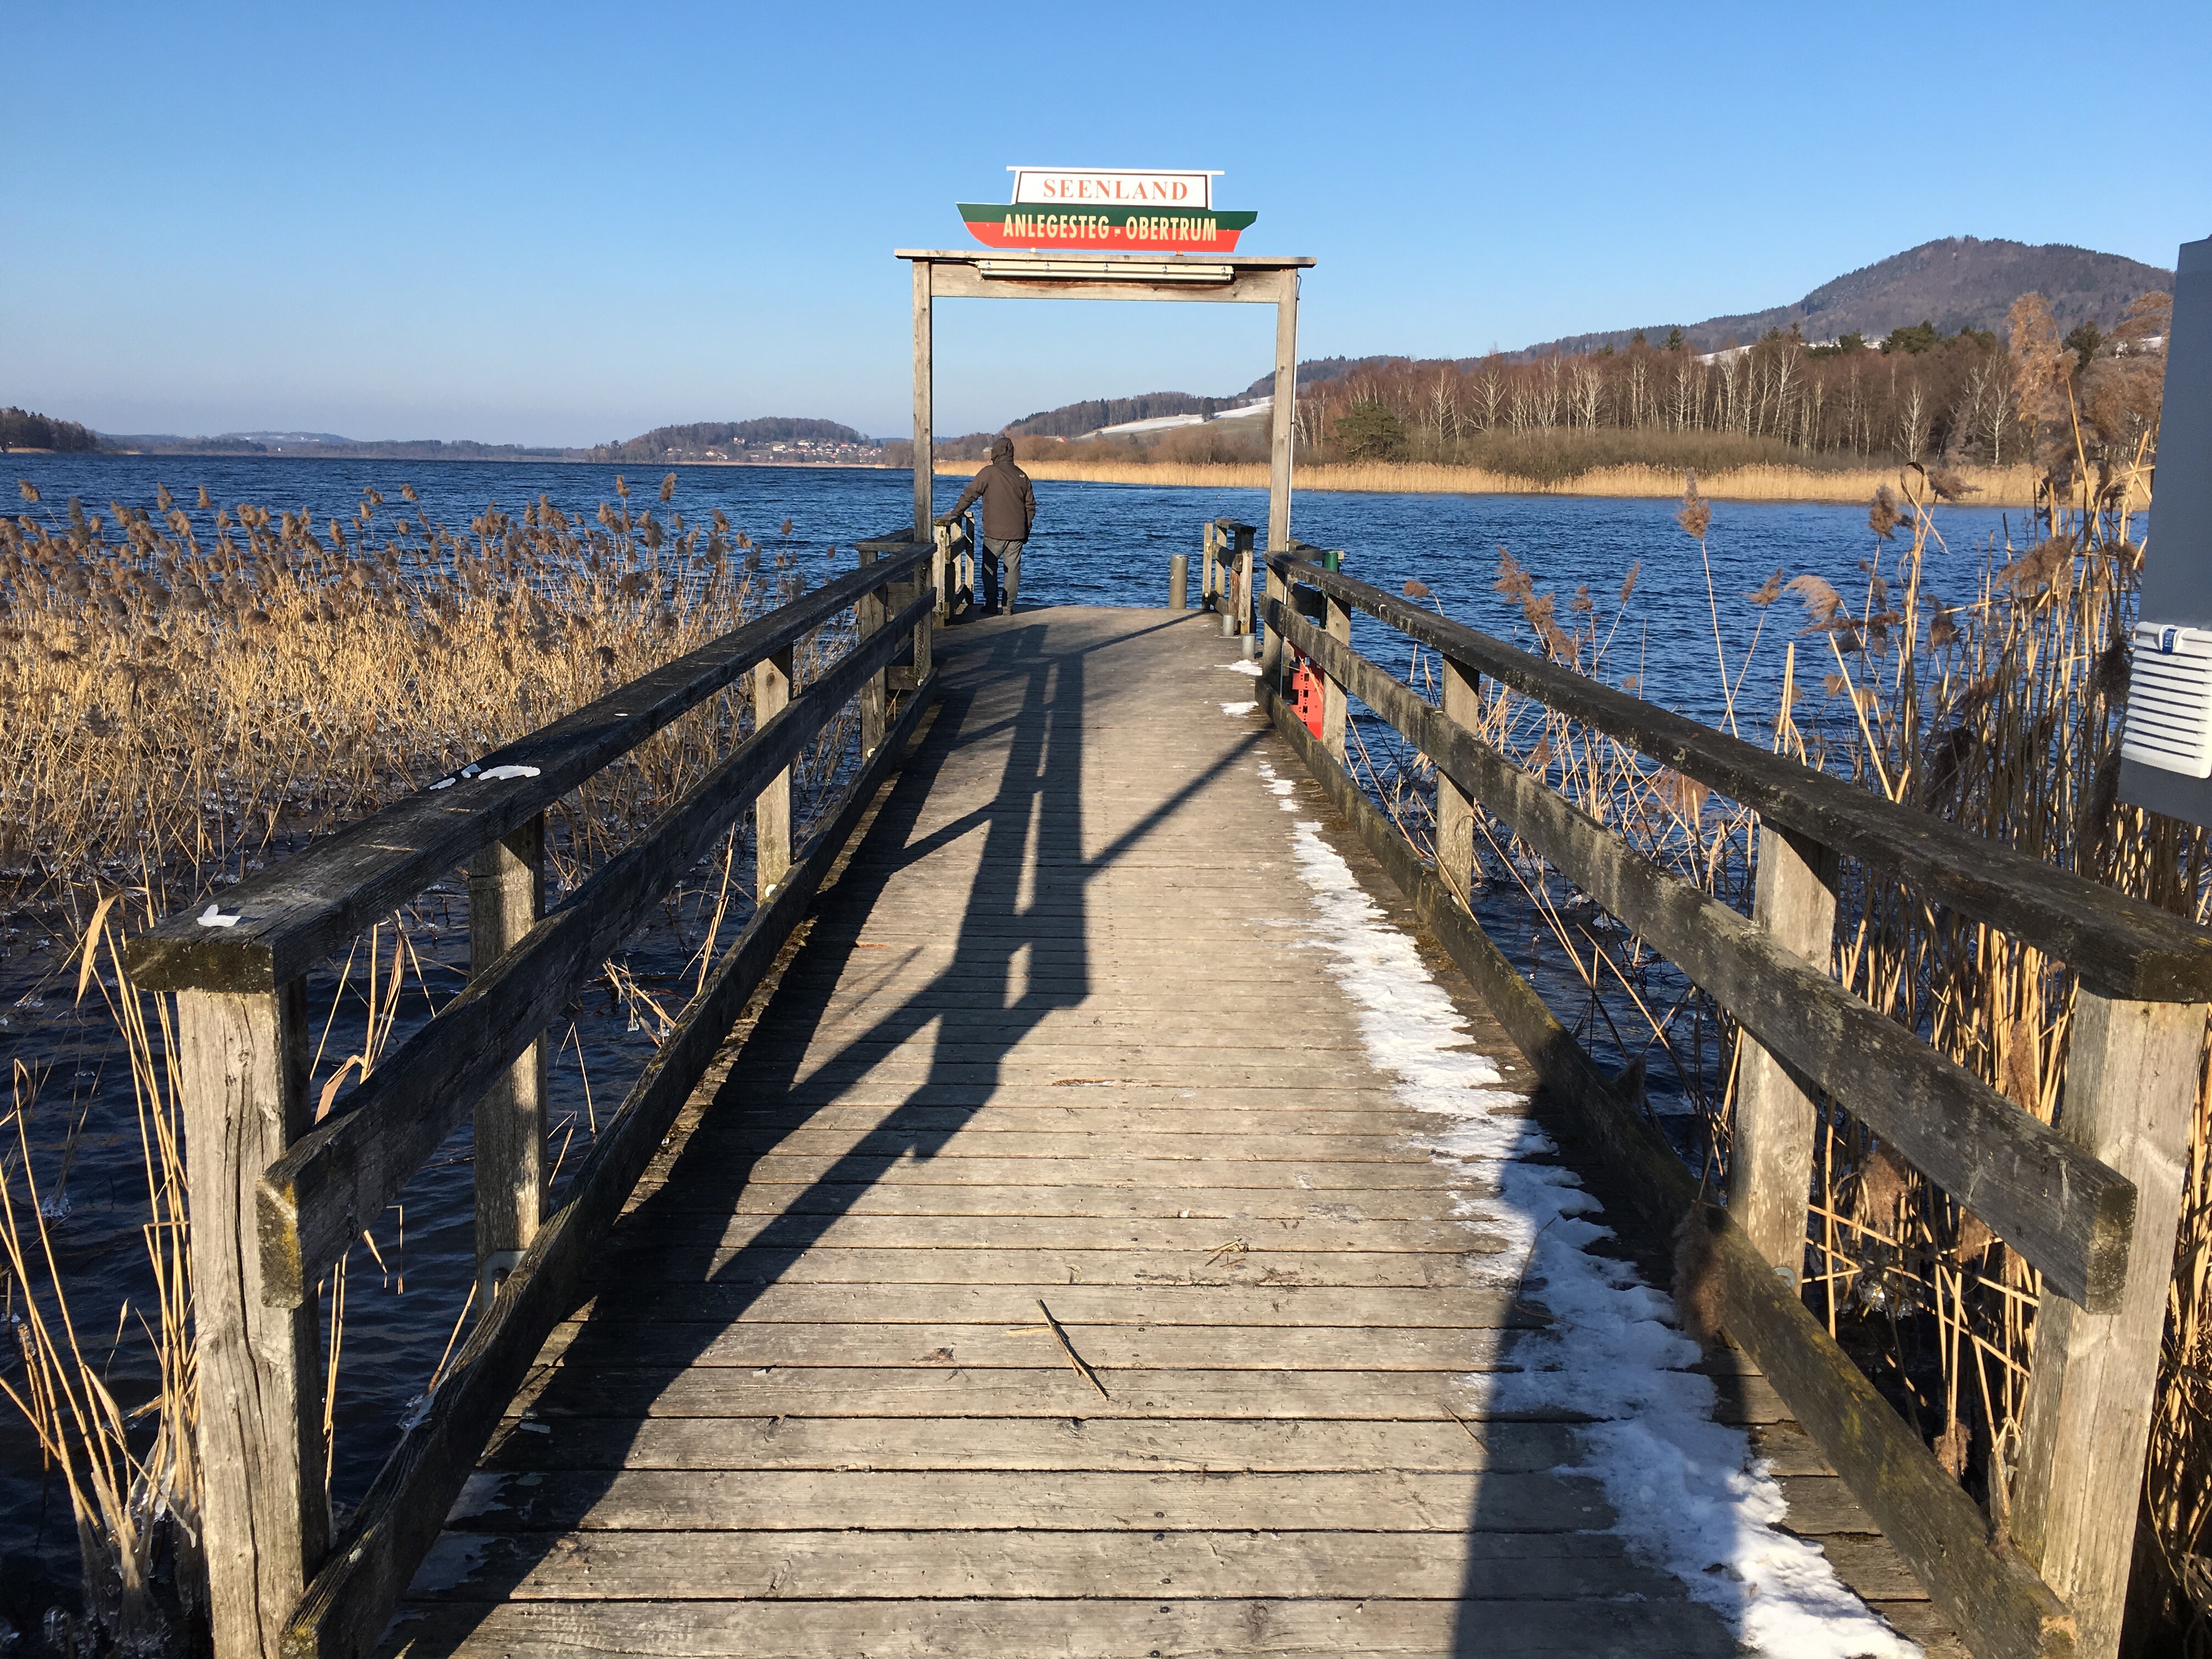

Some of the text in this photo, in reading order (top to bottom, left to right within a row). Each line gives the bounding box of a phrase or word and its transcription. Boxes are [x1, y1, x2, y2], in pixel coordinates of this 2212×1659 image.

[1043, 179, 1187, 200] SEENLAND
[1003, 214, 1109, 239] ANLEGESTEG
[1126, 216, 1216, 241] OBERTRUM
